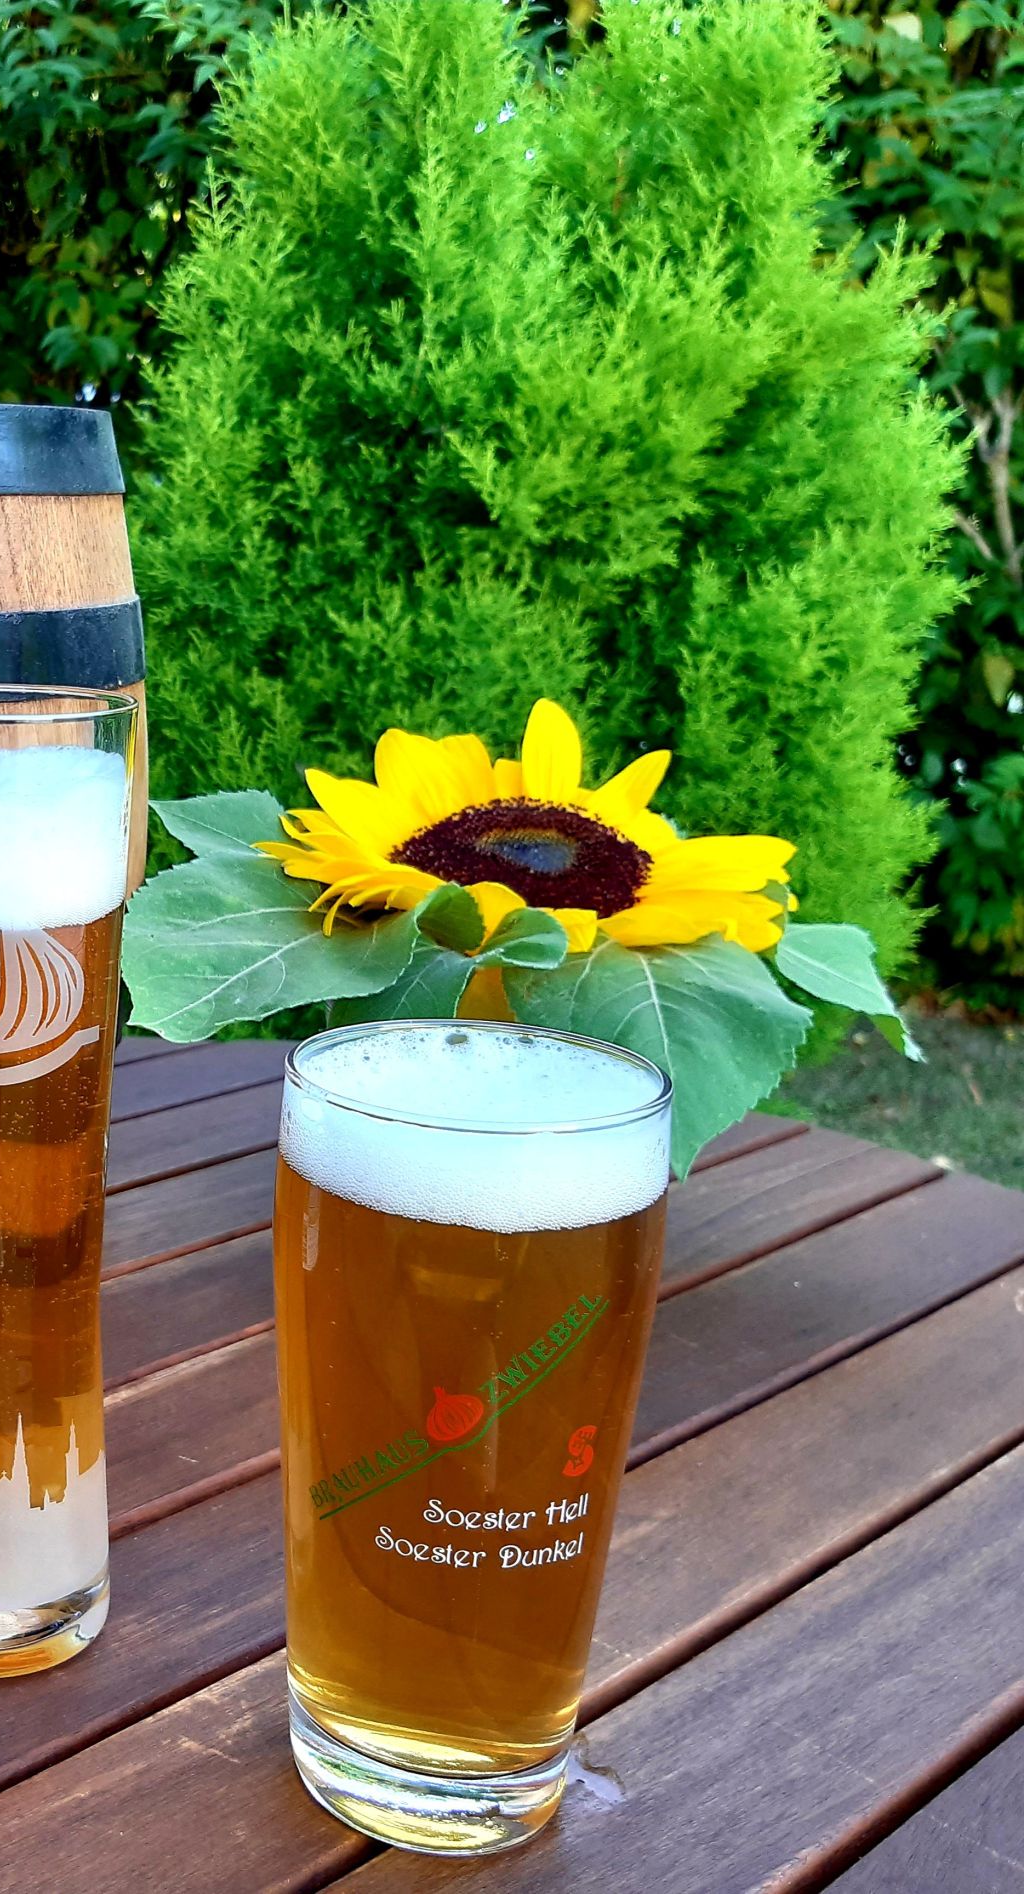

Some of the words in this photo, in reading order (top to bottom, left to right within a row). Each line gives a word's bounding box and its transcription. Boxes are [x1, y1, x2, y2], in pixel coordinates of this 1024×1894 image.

[309, 1430, 429, 1508] BRAUHAUS
[478, 1294, 603, 1405] ZWIEBEL
[423, 1499, 536, 1531] Soester
[545, 1492, 589, 1526] Hell
[374, 1526, 486, 1568] Soester
[499, 1532, 584, 1568] Dunkel
